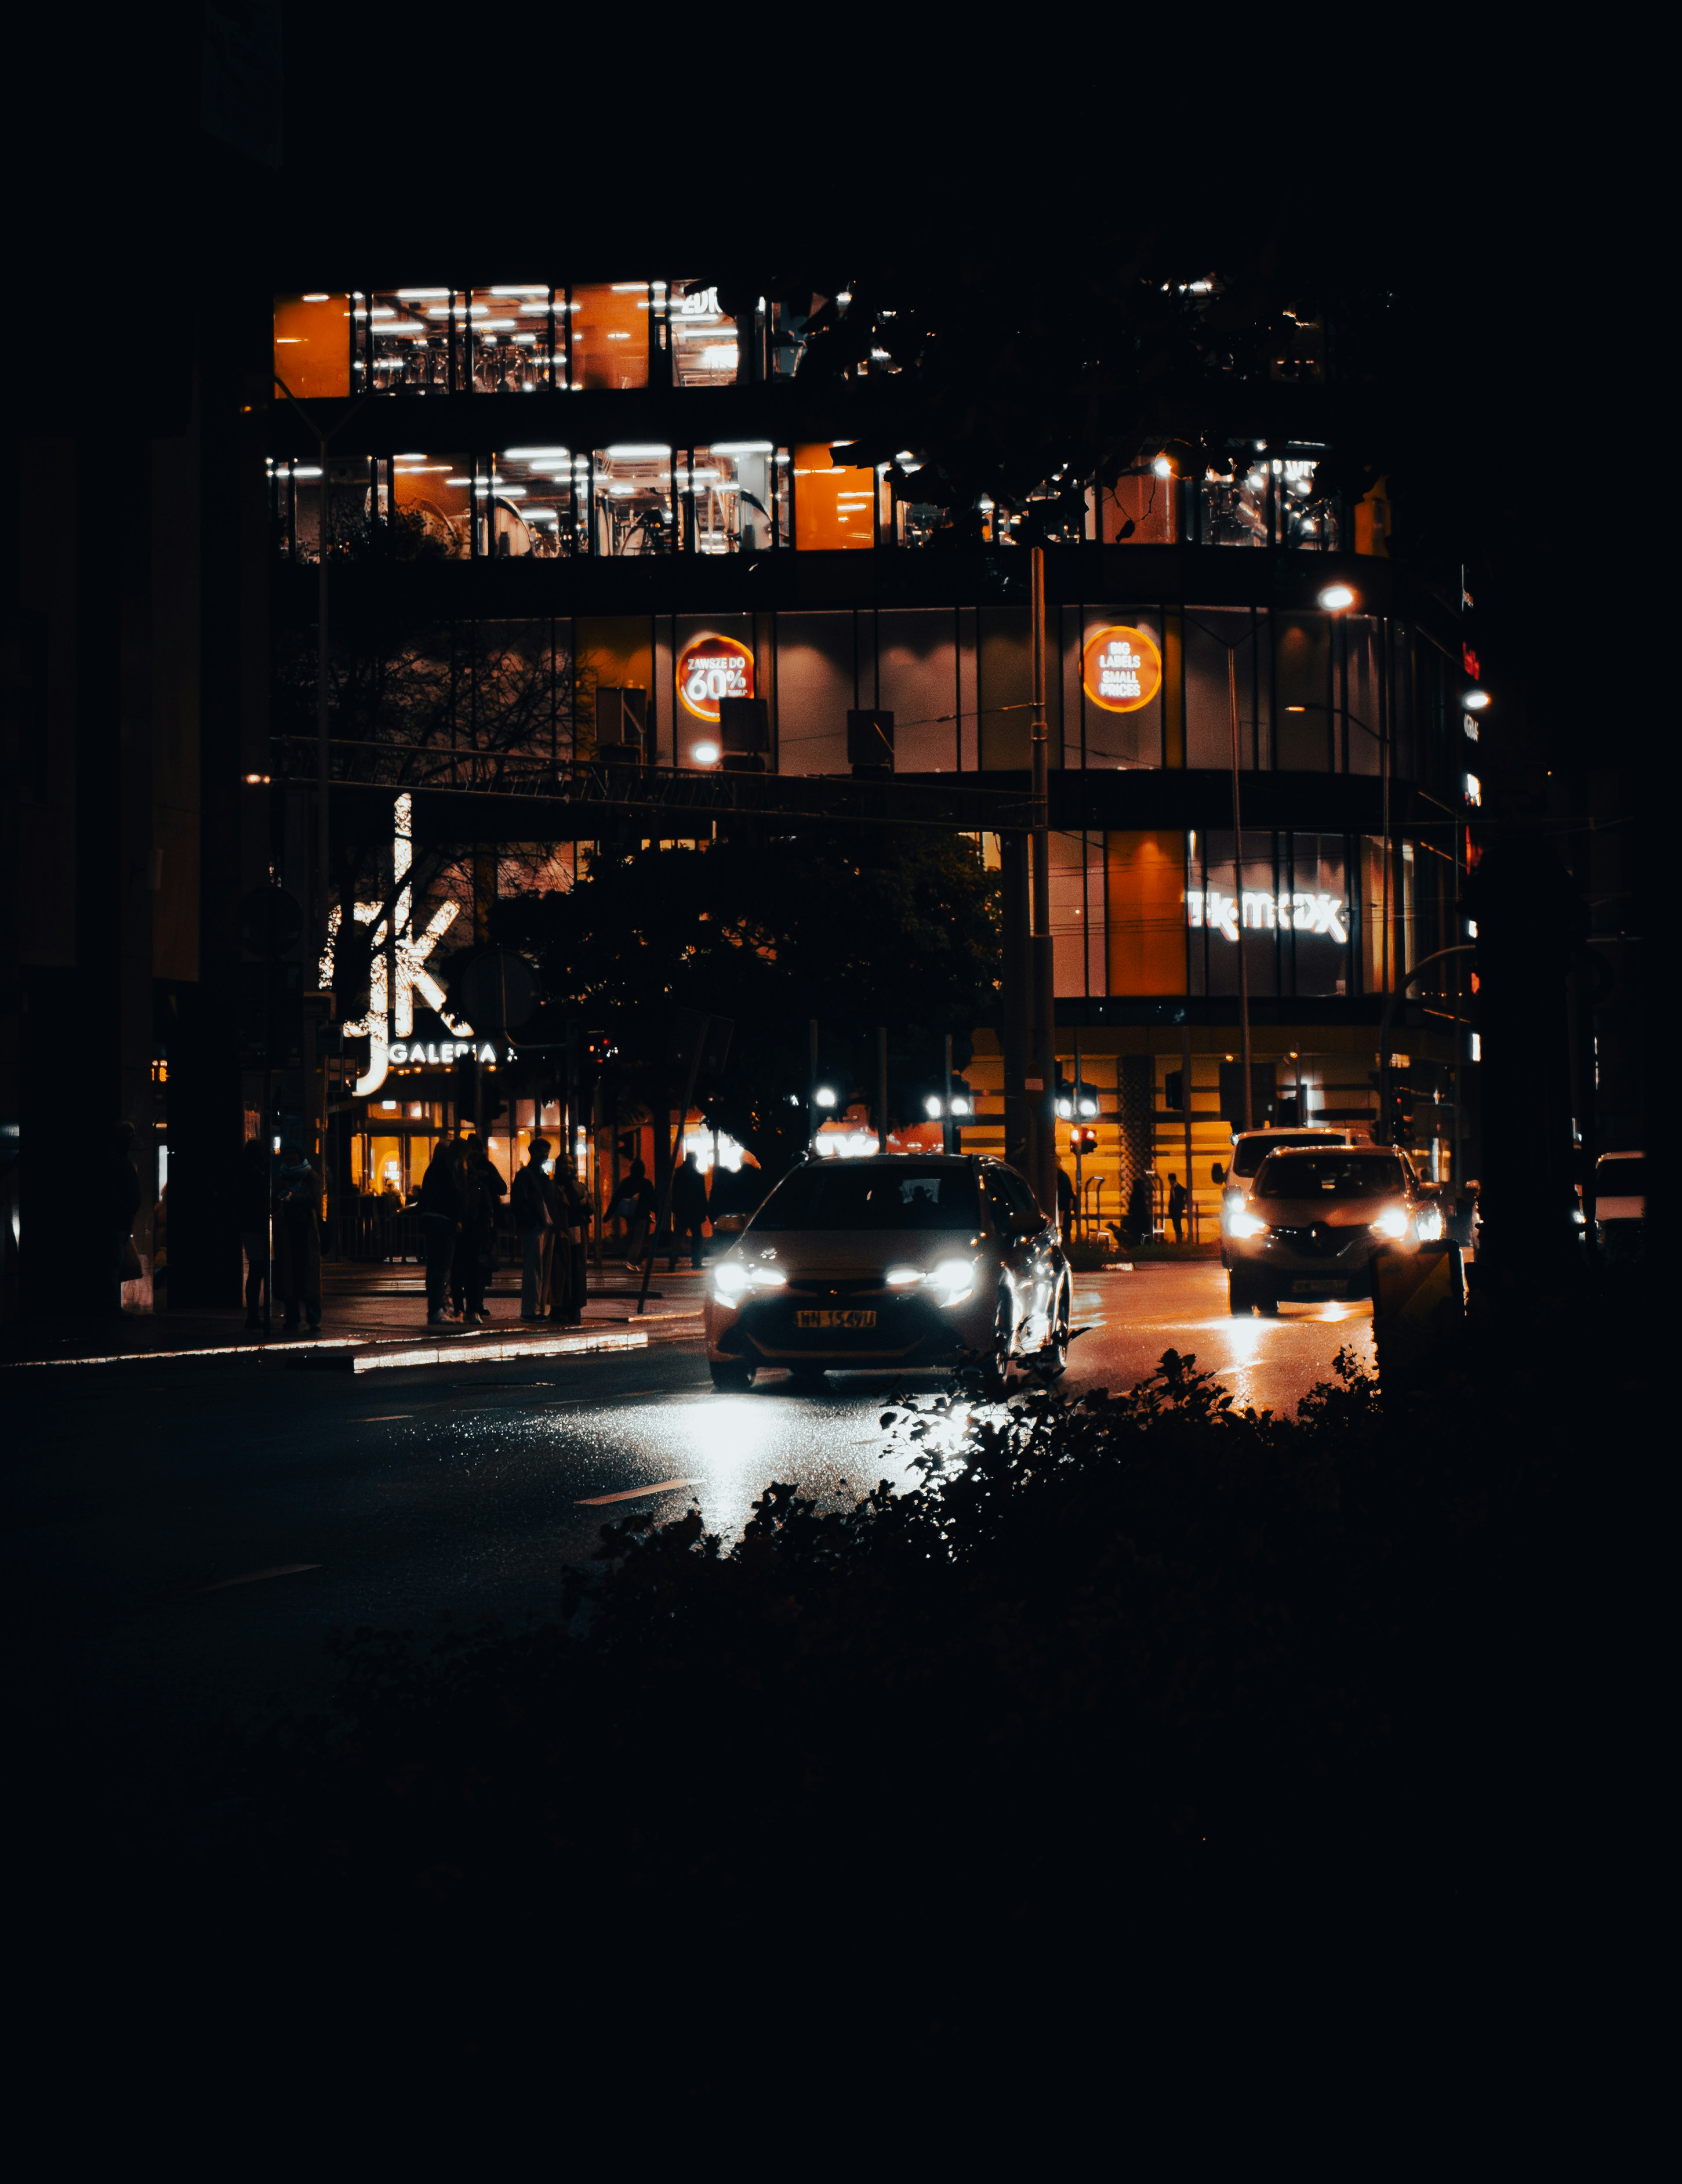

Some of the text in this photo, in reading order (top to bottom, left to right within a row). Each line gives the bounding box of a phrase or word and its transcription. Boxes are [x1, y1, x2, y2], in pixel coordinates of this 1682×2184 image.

[1109, 641, 1131, 655] BIG
[688, 656, 746, 670] ZAWSZE DO
[1099, 655, 1141, 669] LABELS
[1102, 670, 1139, 684] SMALL
[686, 669, 746, 701] 60%
[1099, 683, 1141, 697] PRICES
